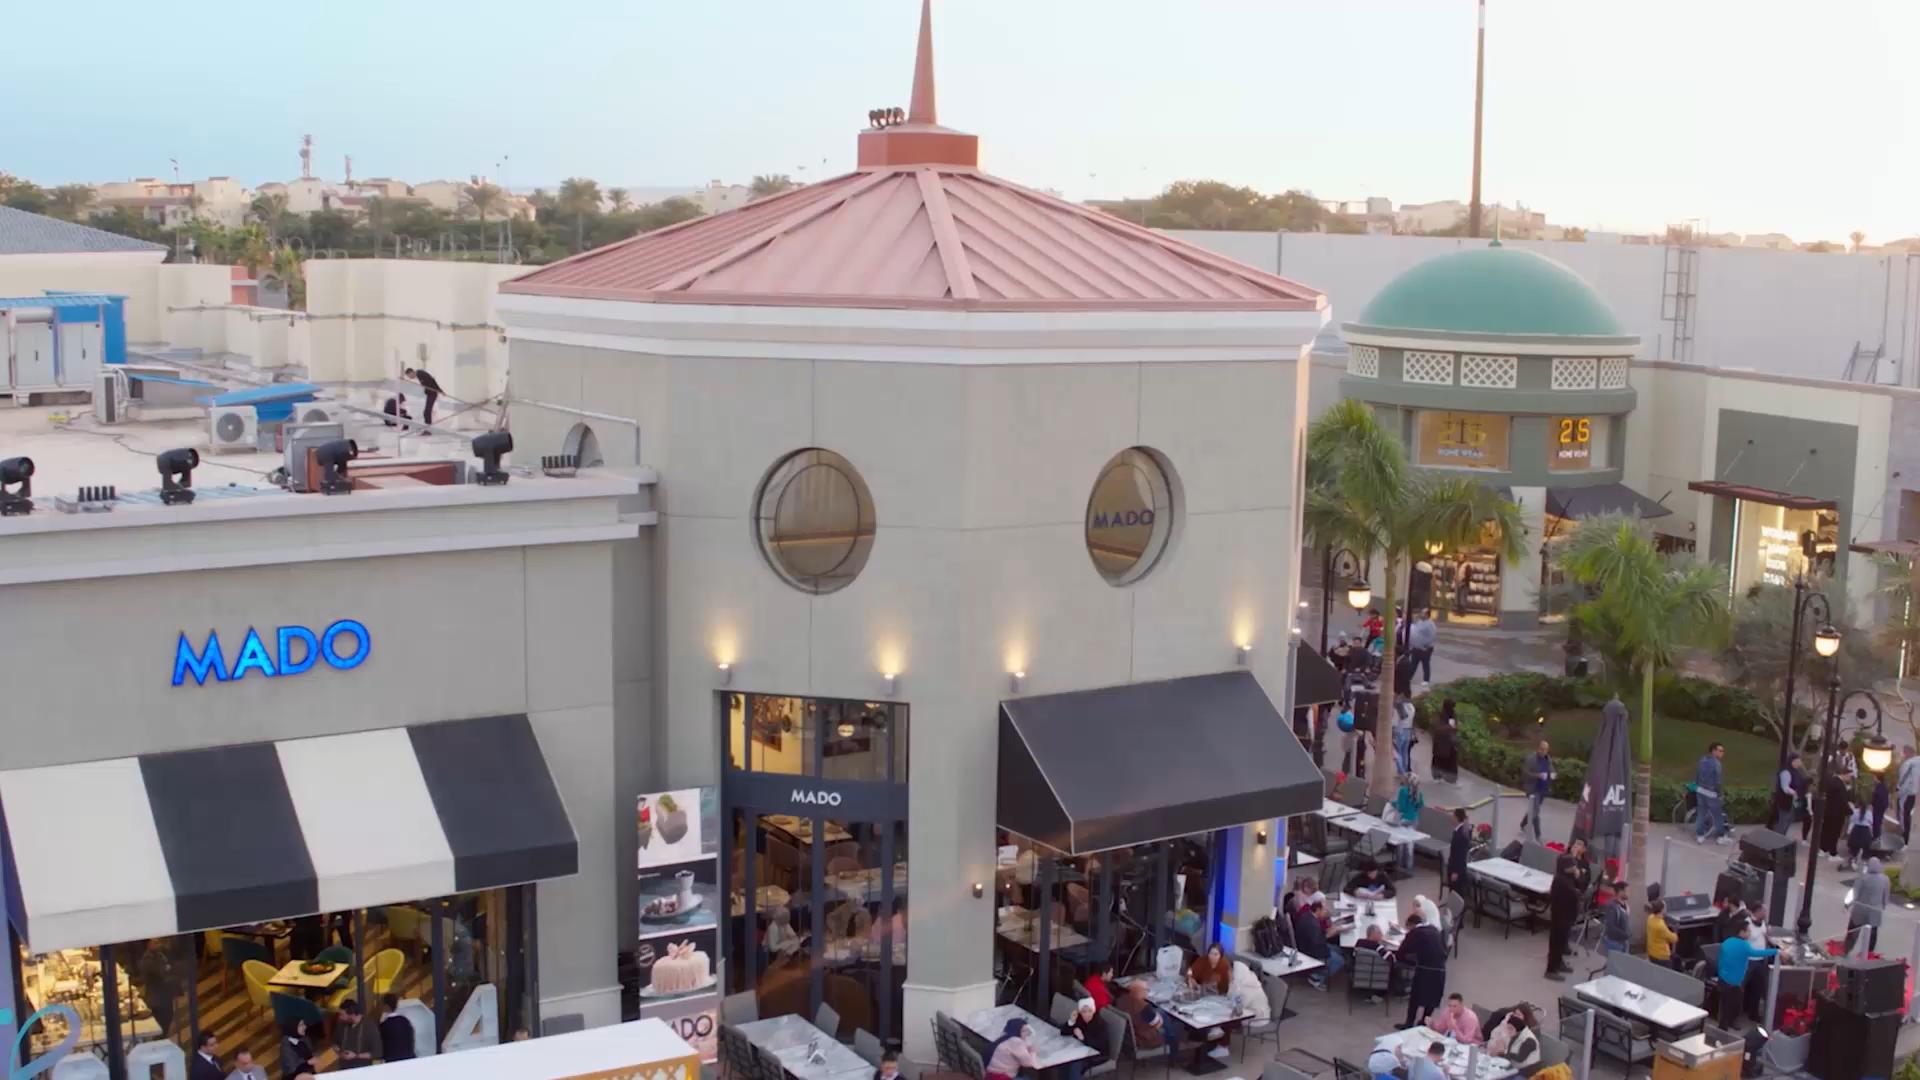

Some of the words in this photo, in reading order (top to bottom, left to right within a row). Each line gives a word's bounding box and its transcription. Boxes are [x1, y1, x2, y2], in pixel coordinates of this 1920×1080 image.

[1093, 508, 1153, 528] MADO
[171, 619, 371, 687] MADO
[791, 788, 841, 806] MADO
